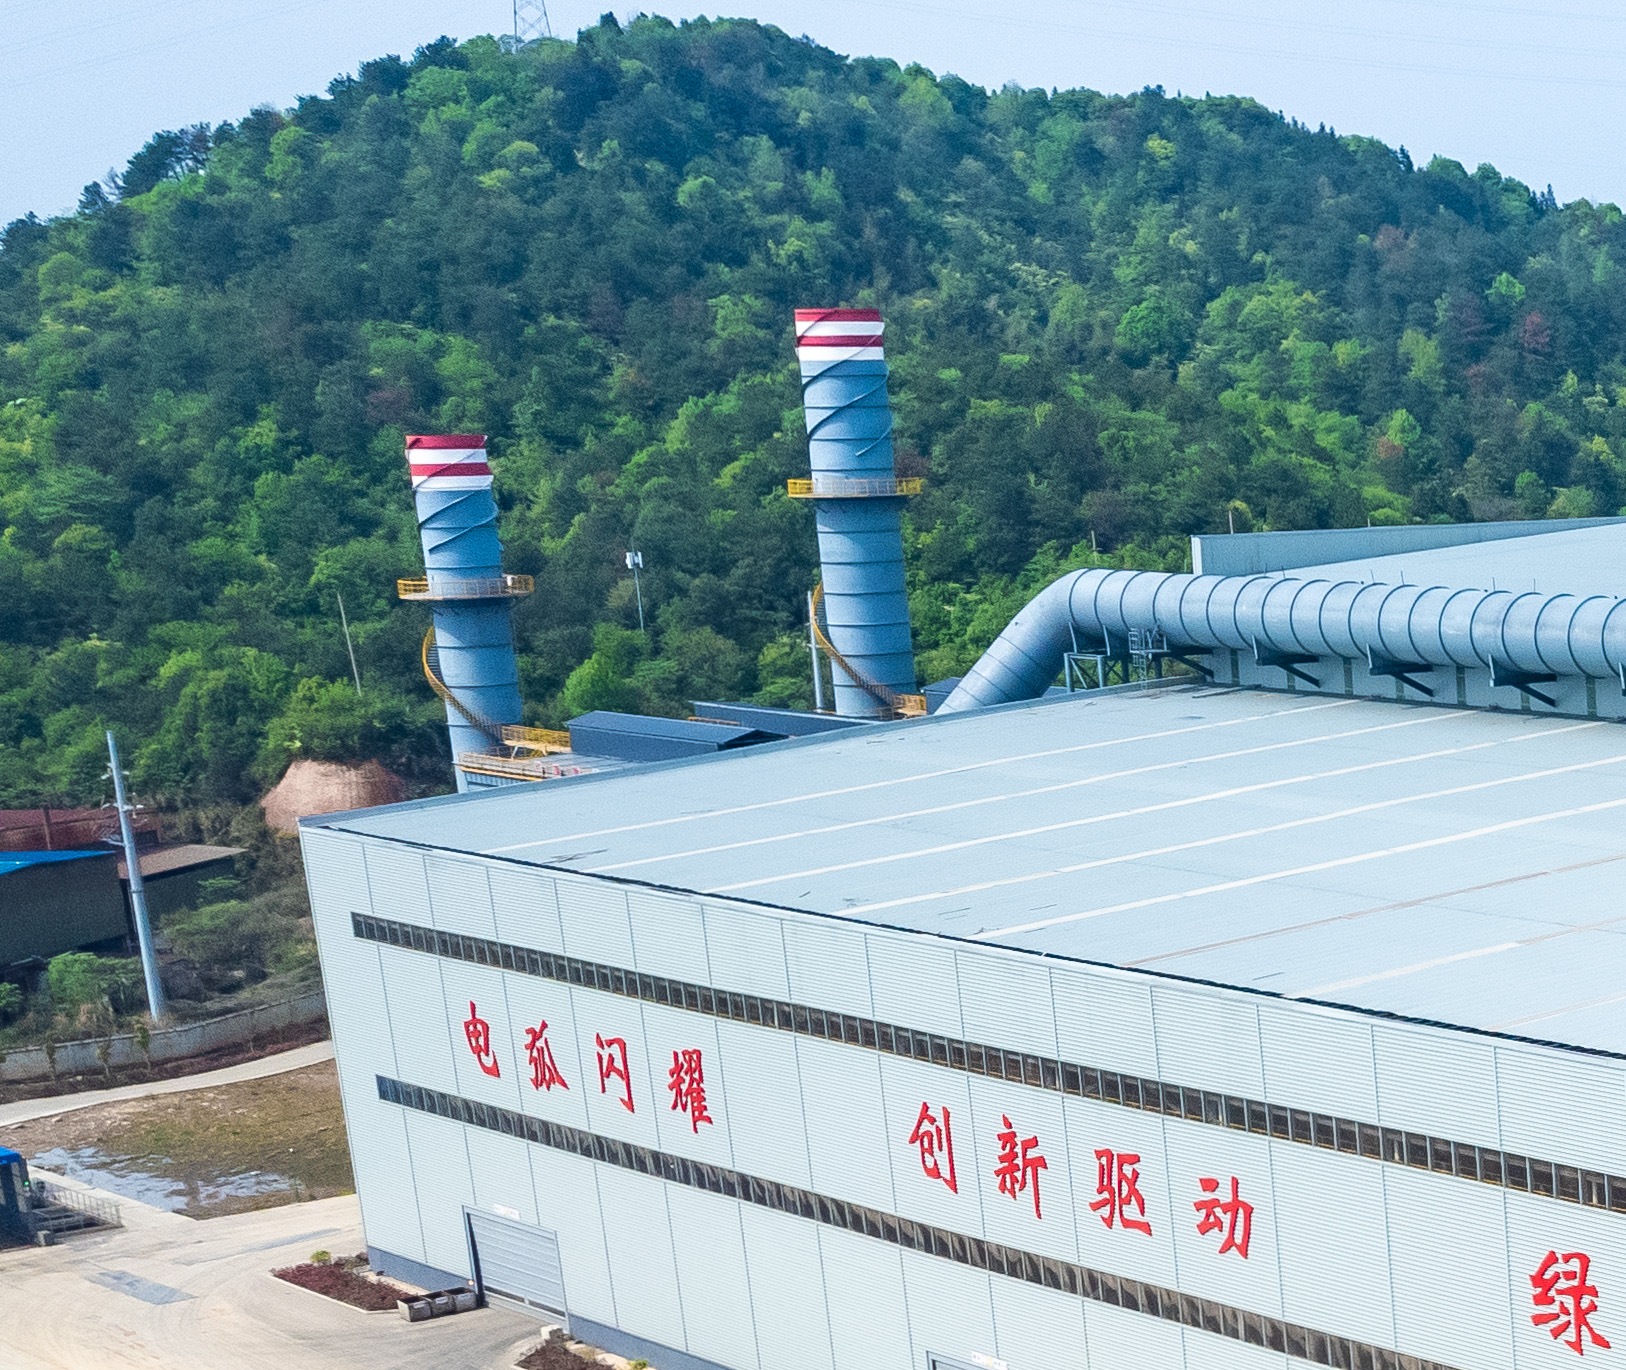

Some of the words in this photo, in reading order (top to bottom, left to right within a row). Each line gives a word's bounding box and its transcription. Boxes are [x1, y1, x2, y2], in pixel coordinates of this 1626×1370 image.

[463, 1001, 713, 1133] 电弧闪耀
[908, 1101, 1254, 1259] 创新驱动
